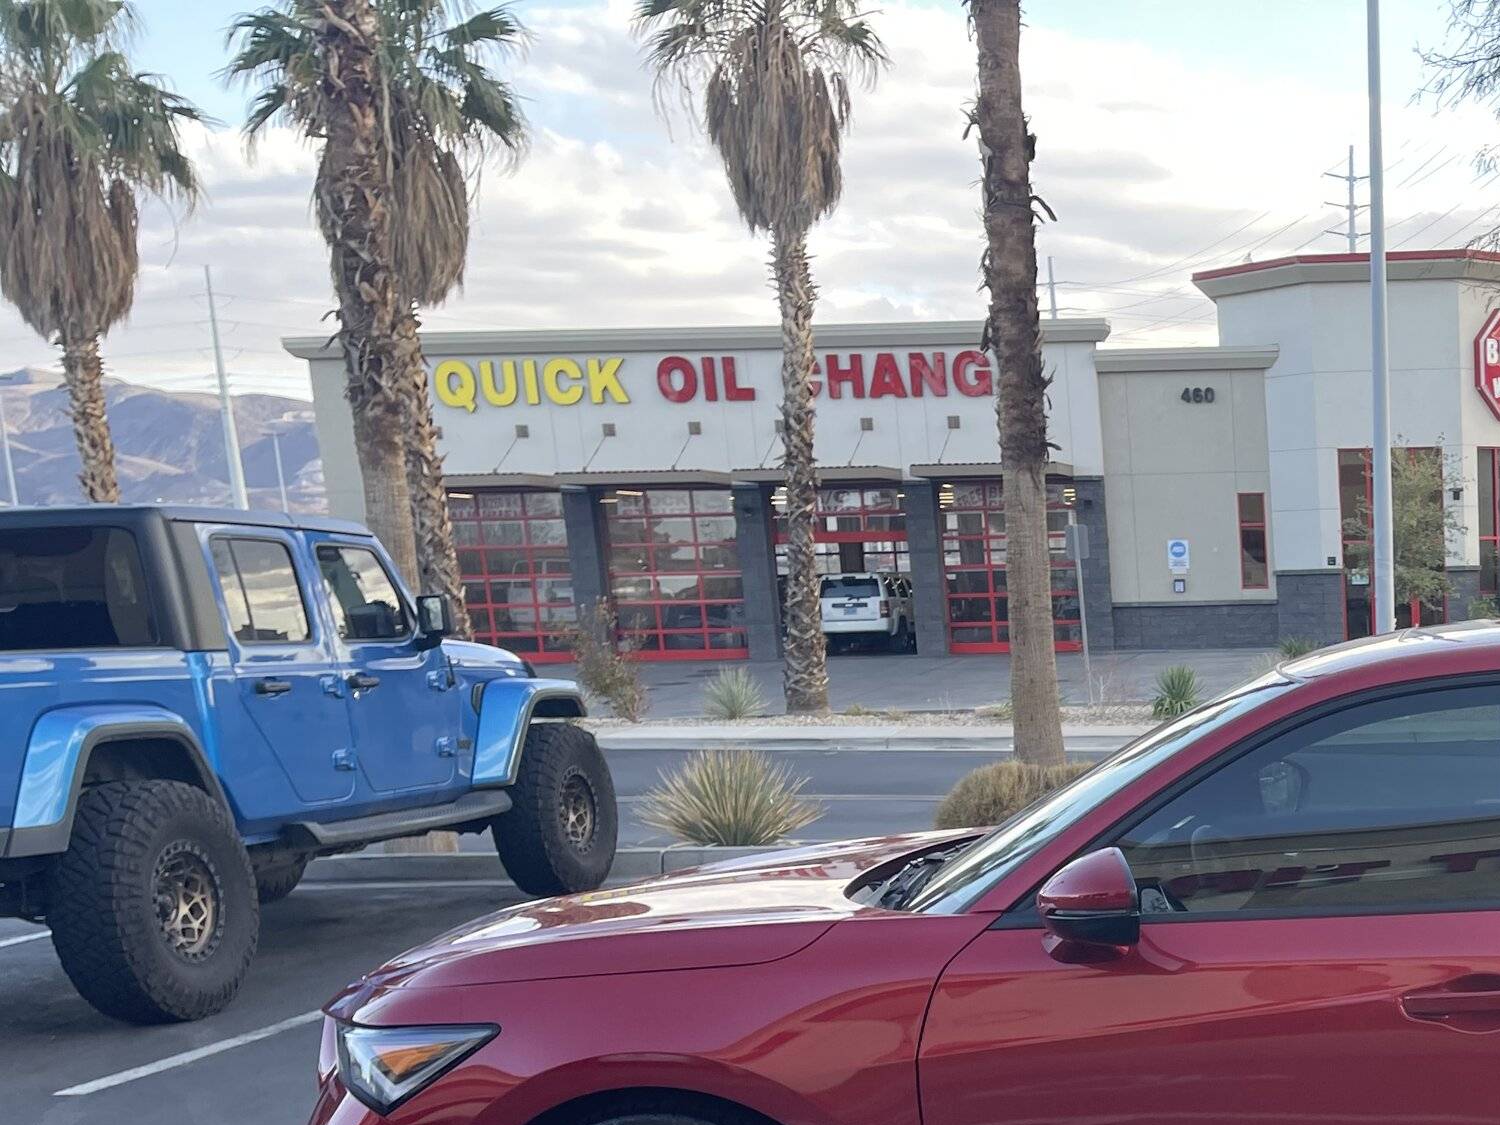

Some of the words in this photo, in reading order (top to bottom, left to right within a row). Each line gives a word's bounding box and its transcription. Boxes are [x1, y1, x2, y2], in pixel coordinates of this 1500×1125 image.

[433, 356, 631, 414] QUICK
[656, 355, 756, 404] OIL
[808, 349, 994, 400] HANG
[1181, 387, 1215, 403] 460
